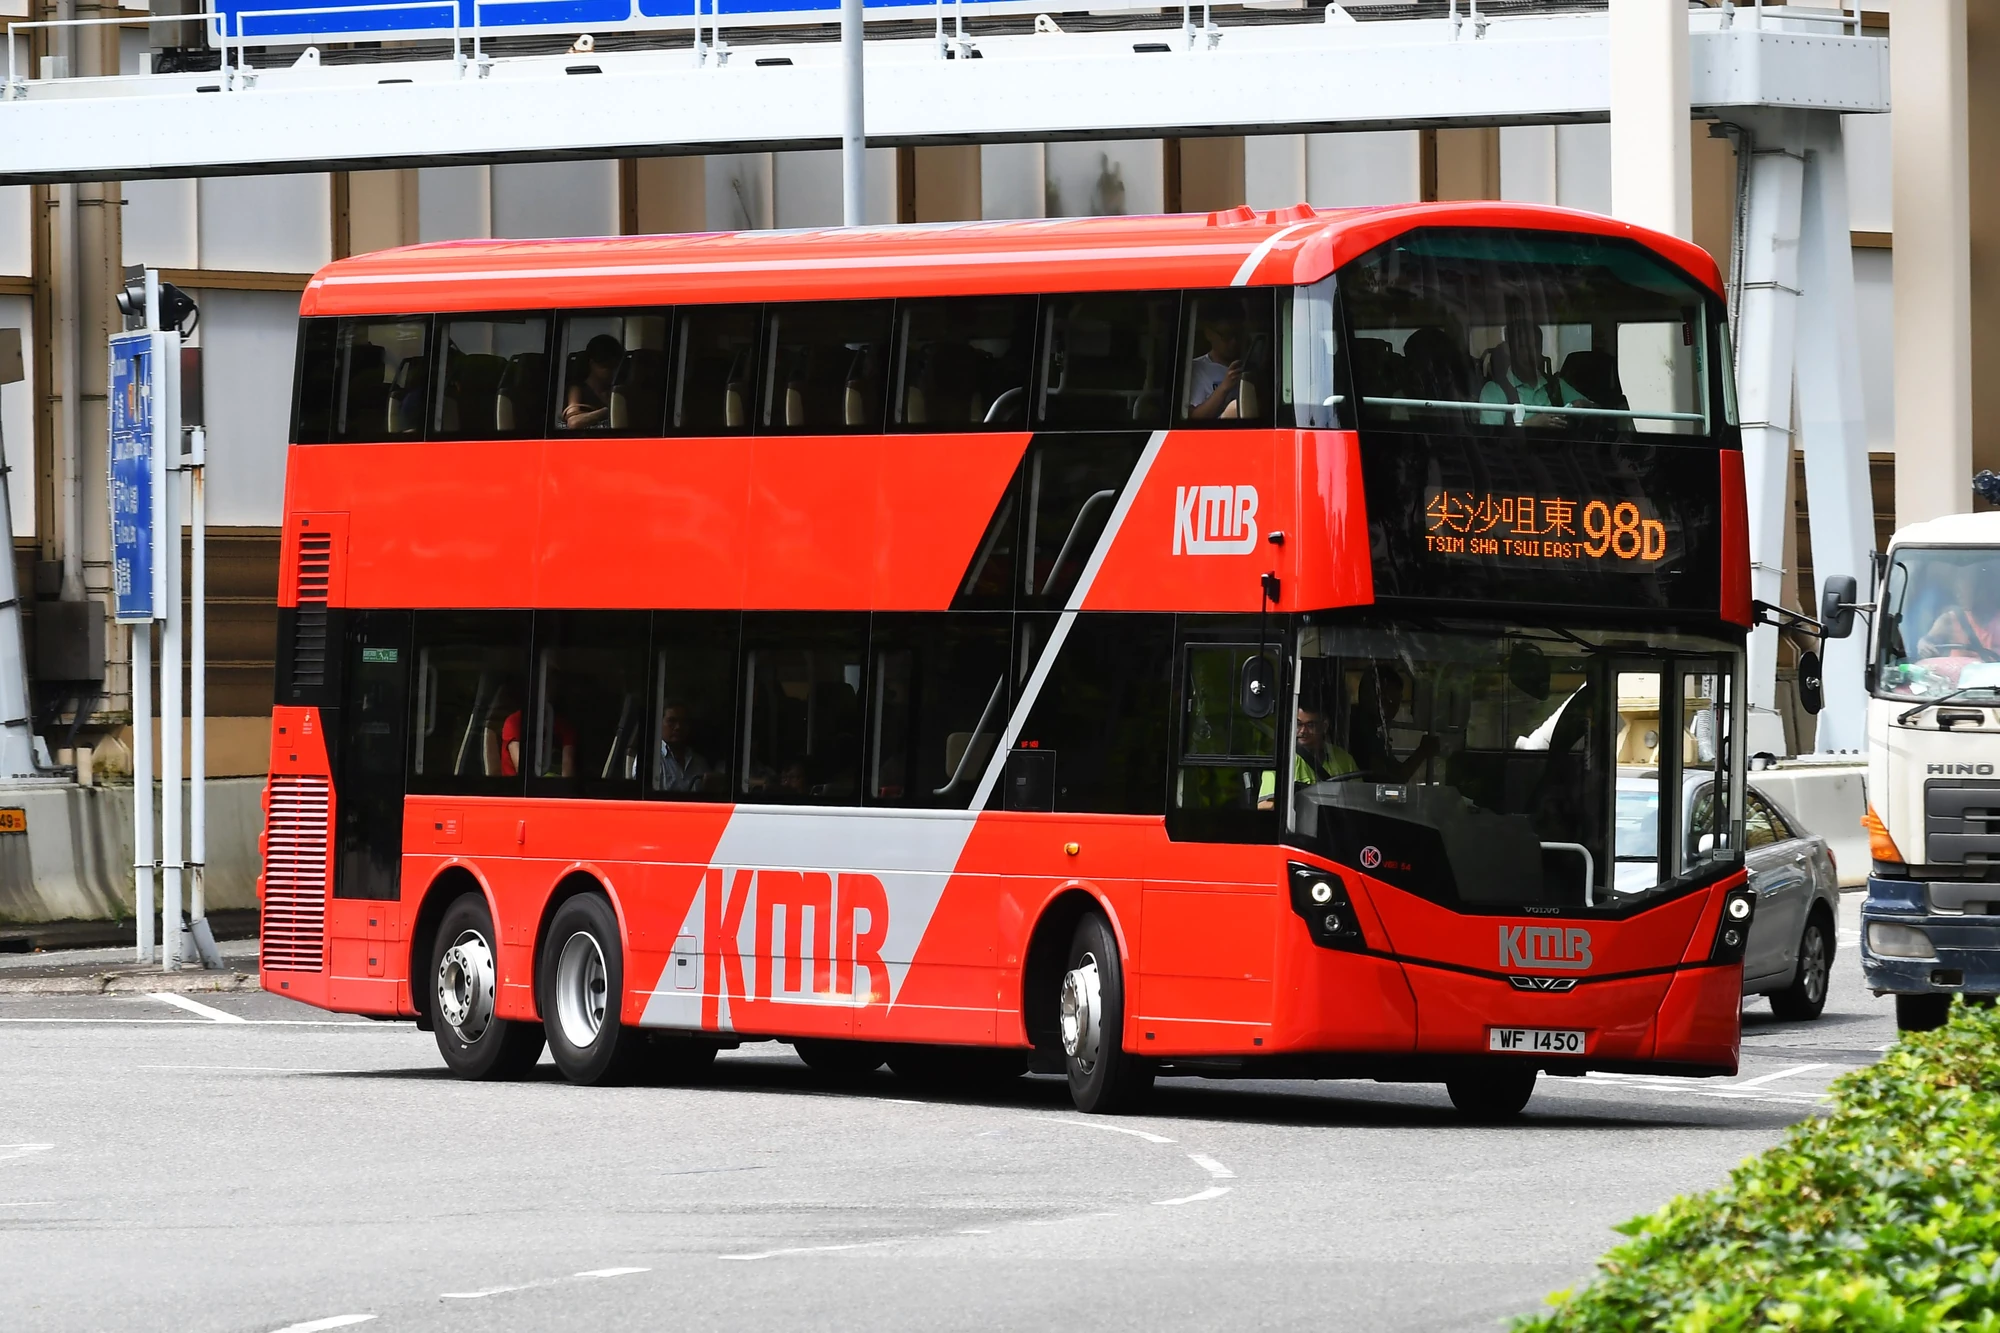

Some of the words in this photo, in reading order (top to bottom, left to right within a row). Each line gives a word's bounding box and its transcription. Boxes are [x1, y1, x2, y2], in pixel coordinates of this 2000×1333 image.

[1172, 485, 1259, 556] KMB
[1426, 491, 1578, 537] 尖沙咀東
[1583, 500, 1666, 560] 98D
[1425, 535, 1465, 553] TSIM
[1470, 537, 1499, 555] SHA
[1502, 539, 1540, 557] TSUI
[1543, 541, 1583, 559] EAST
[1927, 763, 1994, 775] HINO
[1523, 906, 1560, 914] VOLVO
[701, 868, 891, 1032] KMB
[1499, 925, 1593, 970] KMB
[1500, 1030, 1525, 1049] WF
[1533, 1032, 1579, 1051] 1450
